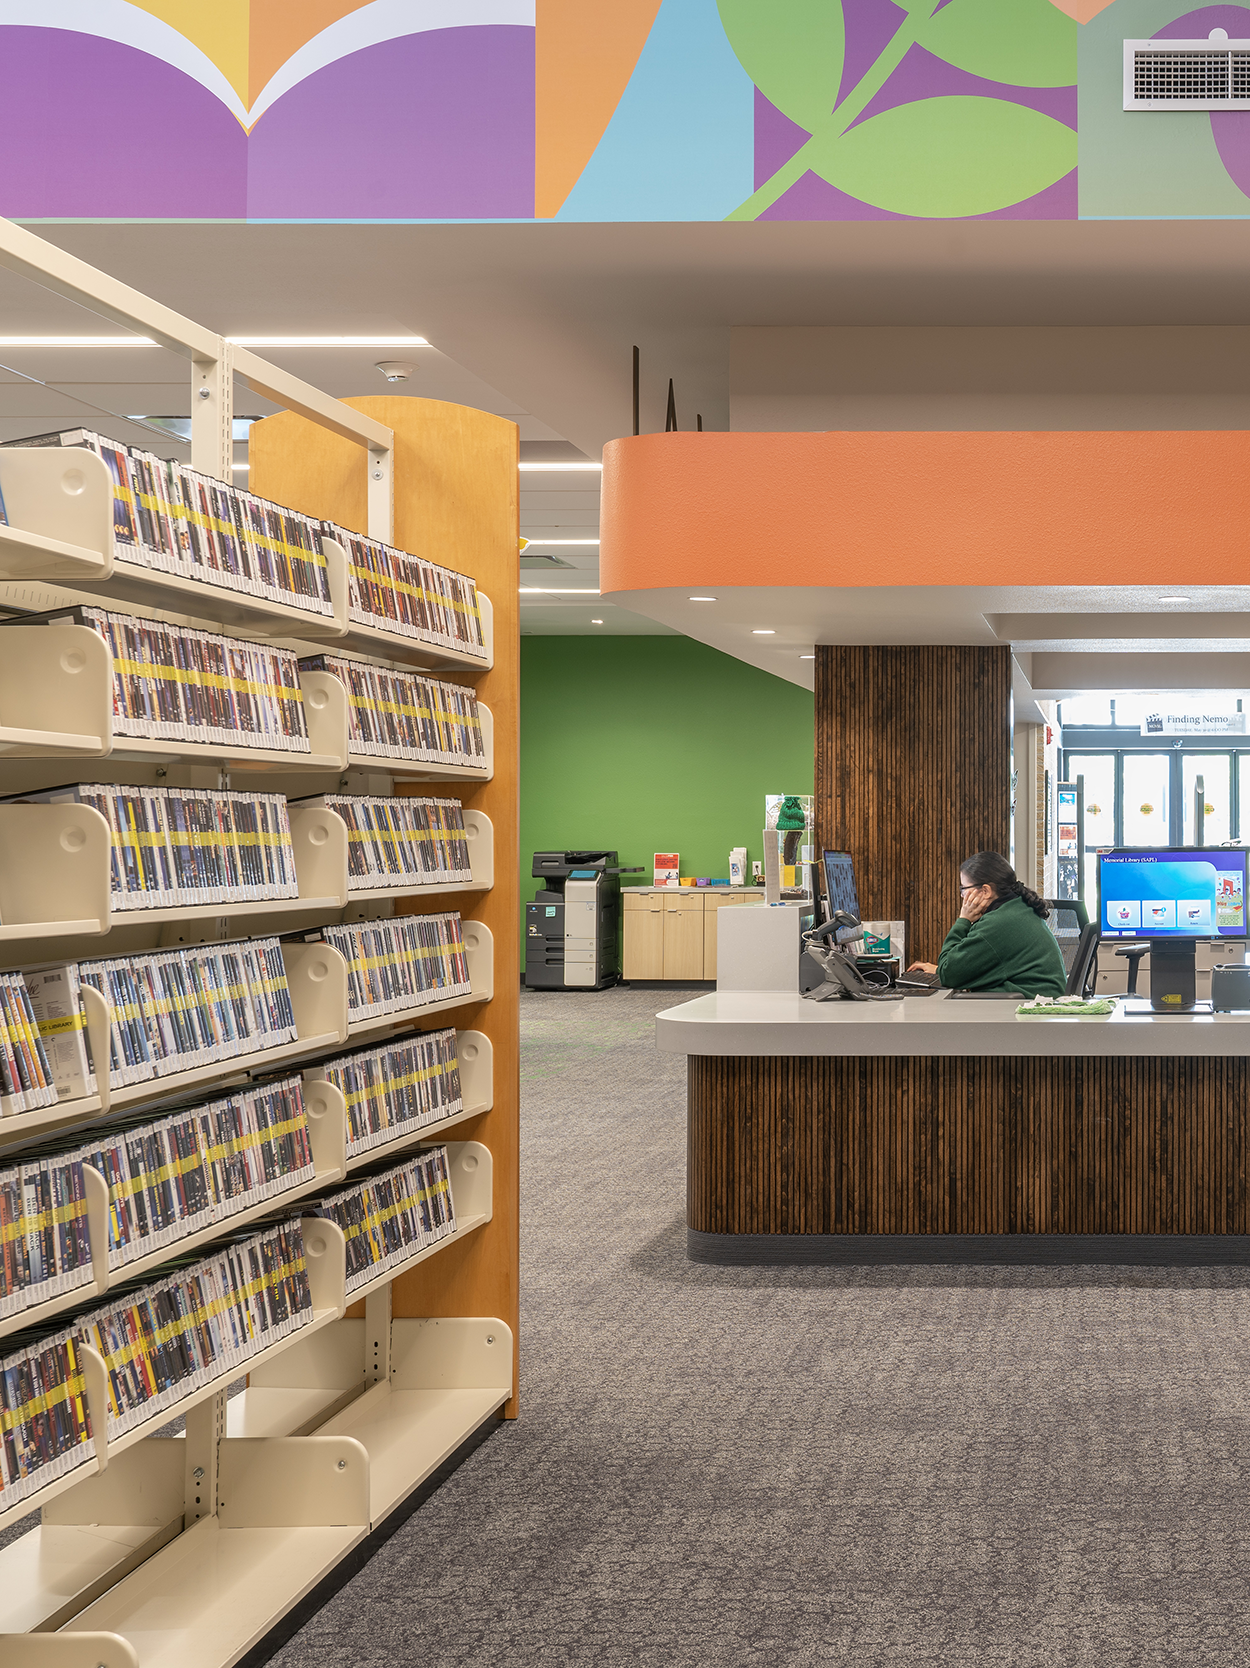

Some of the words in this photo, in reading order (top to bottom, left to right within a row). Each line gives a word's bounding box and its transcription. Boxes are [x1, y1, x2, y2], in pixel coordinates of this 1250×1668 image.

[1167, 715, 1200, 725] Finding
[1202, 715, 1228, 723] Nemo
[49, 1021, 73, 1030] LIBRARY
